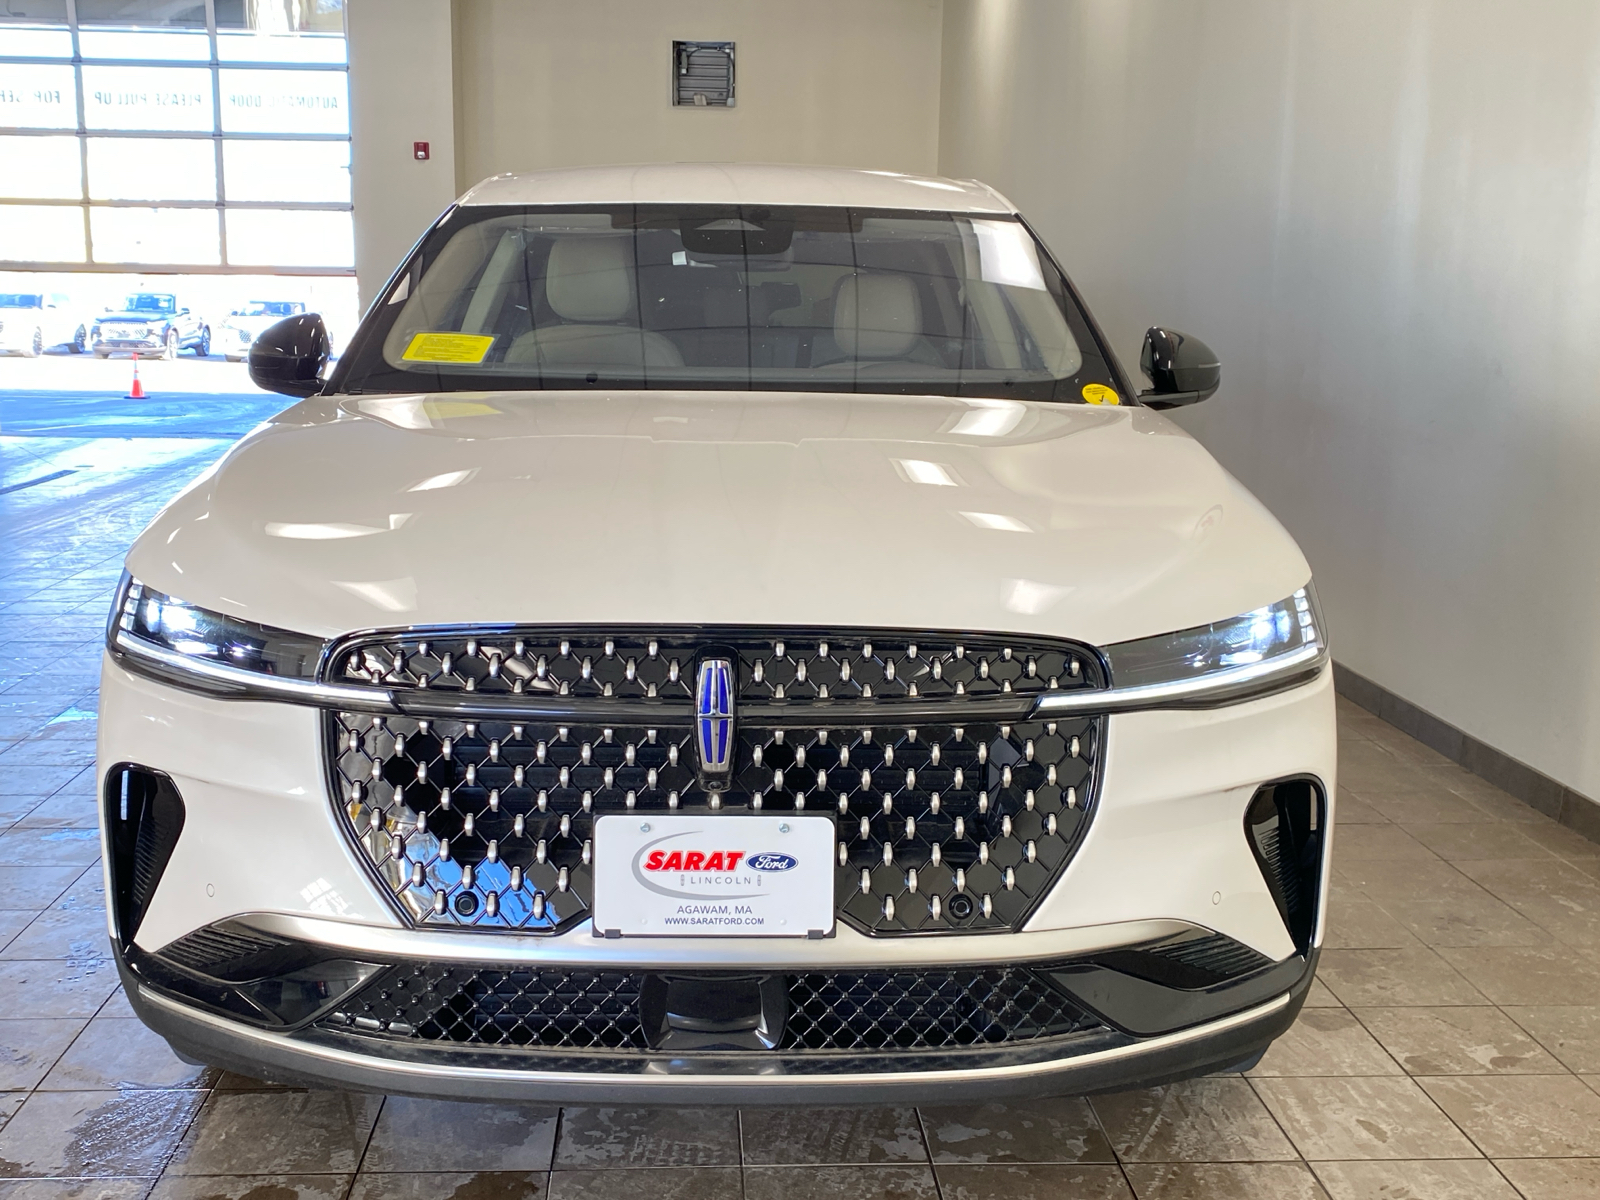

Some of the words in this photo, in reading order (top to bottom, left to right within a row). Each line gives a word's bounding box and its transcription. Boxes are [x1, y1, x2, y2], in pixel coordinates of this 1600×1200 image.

[644, 850, 746, 873] SARAT
[690, 876, 752, 885] LINCOLN
[677, 905, 732, 916] AGAWAM,
[735, 905, 753, 914] MA
[664, 917, 765, 925] WWW.SARATFORD.COM
